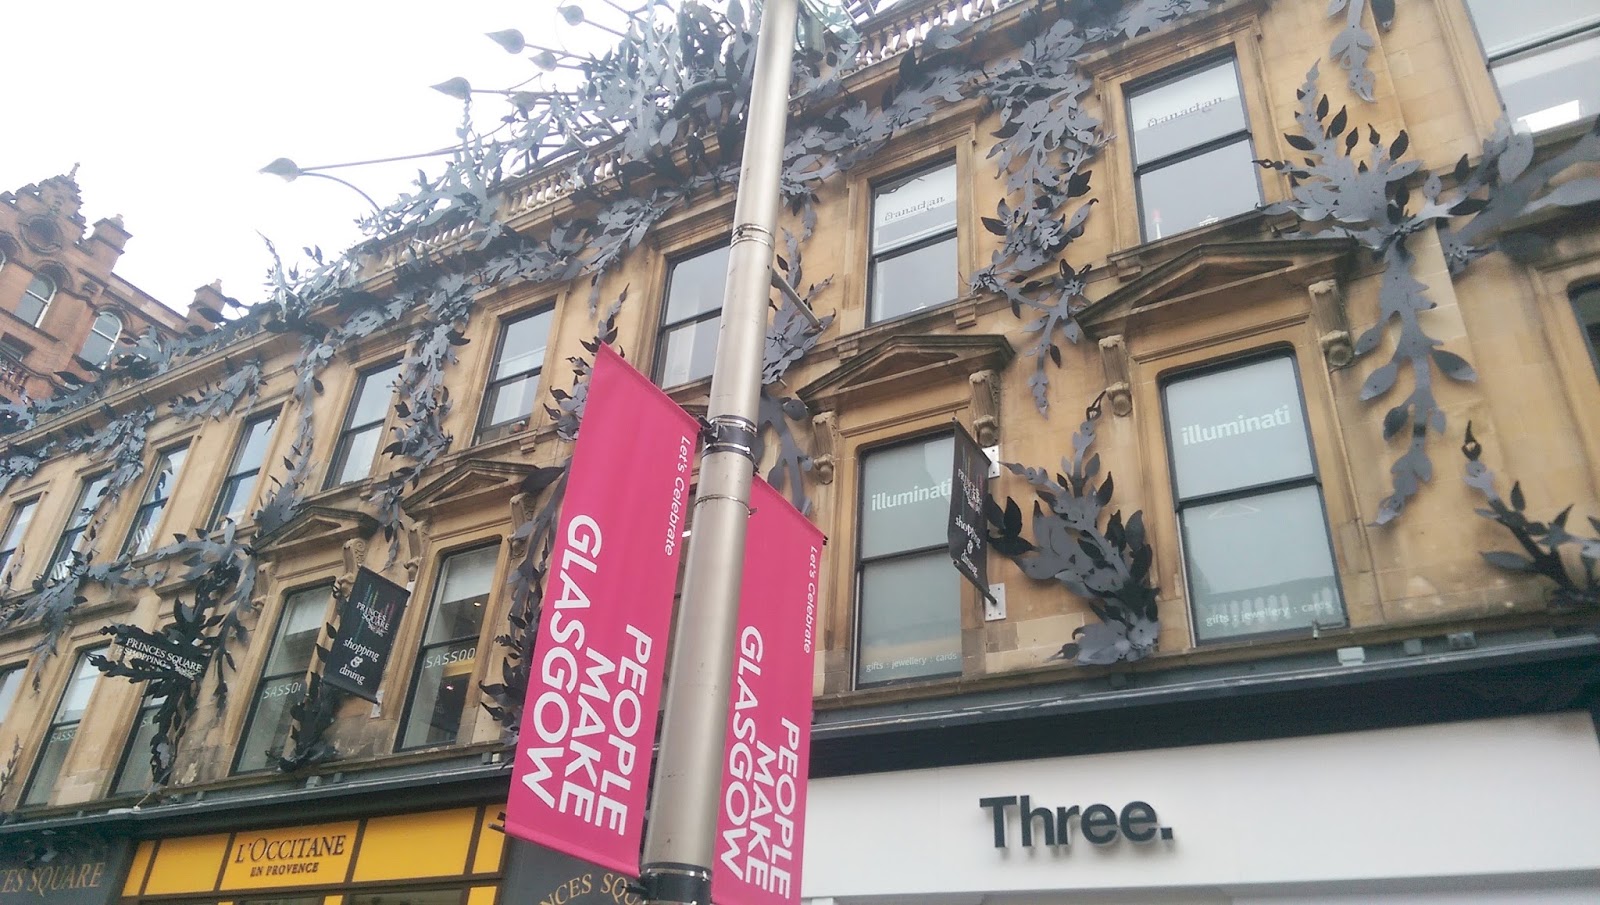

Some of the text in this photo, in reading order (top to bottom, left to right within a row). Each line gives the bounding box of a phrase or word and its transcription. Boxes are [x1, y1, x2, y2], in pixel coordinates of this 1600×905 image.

[1181, 404, 1291, 446] illuminati
[664, 435, 691, 556] Let's Celebrate
[871, 477, 952, 512] illuminati
[356, 602, 387, 621] PRINCES
[803, 545, 818, 654] Let's Celebrate
[361, 612, 390, 631] SQUARE
[123, 647, 168, 669] SHOPPING
[126, 637, 166, 659] PRINCES
[166, 652, 203, 672] SQUARE
[342, 637, 380, 663] shopping
[349, 655, 364, 669] &
[521, 514, 603, 809] GLASGOW
[865, 661, 884, 673] gifts
[891, 656, 927, 669] jewellery
[935, 652, 957, 663] cards
[263, 682, 302, 699] SASSO
[339, 663, 366, 686] dining
[558, 646, 616, 823] MAKE
[594, 624, 653, 836] PEOPLE
[721, 625, 764, 881] GLASGOW
[745, 741, 777, 891] MAKE
[768, 717, 800, 900] PEOPLE
[979, 794, 1174, 849] Three.
[234, 835, 347, 863] L'OCCITANE
[27, 862, 106, 898] SQUARE
[250, 862, 319, 877] EN PROVENCE
